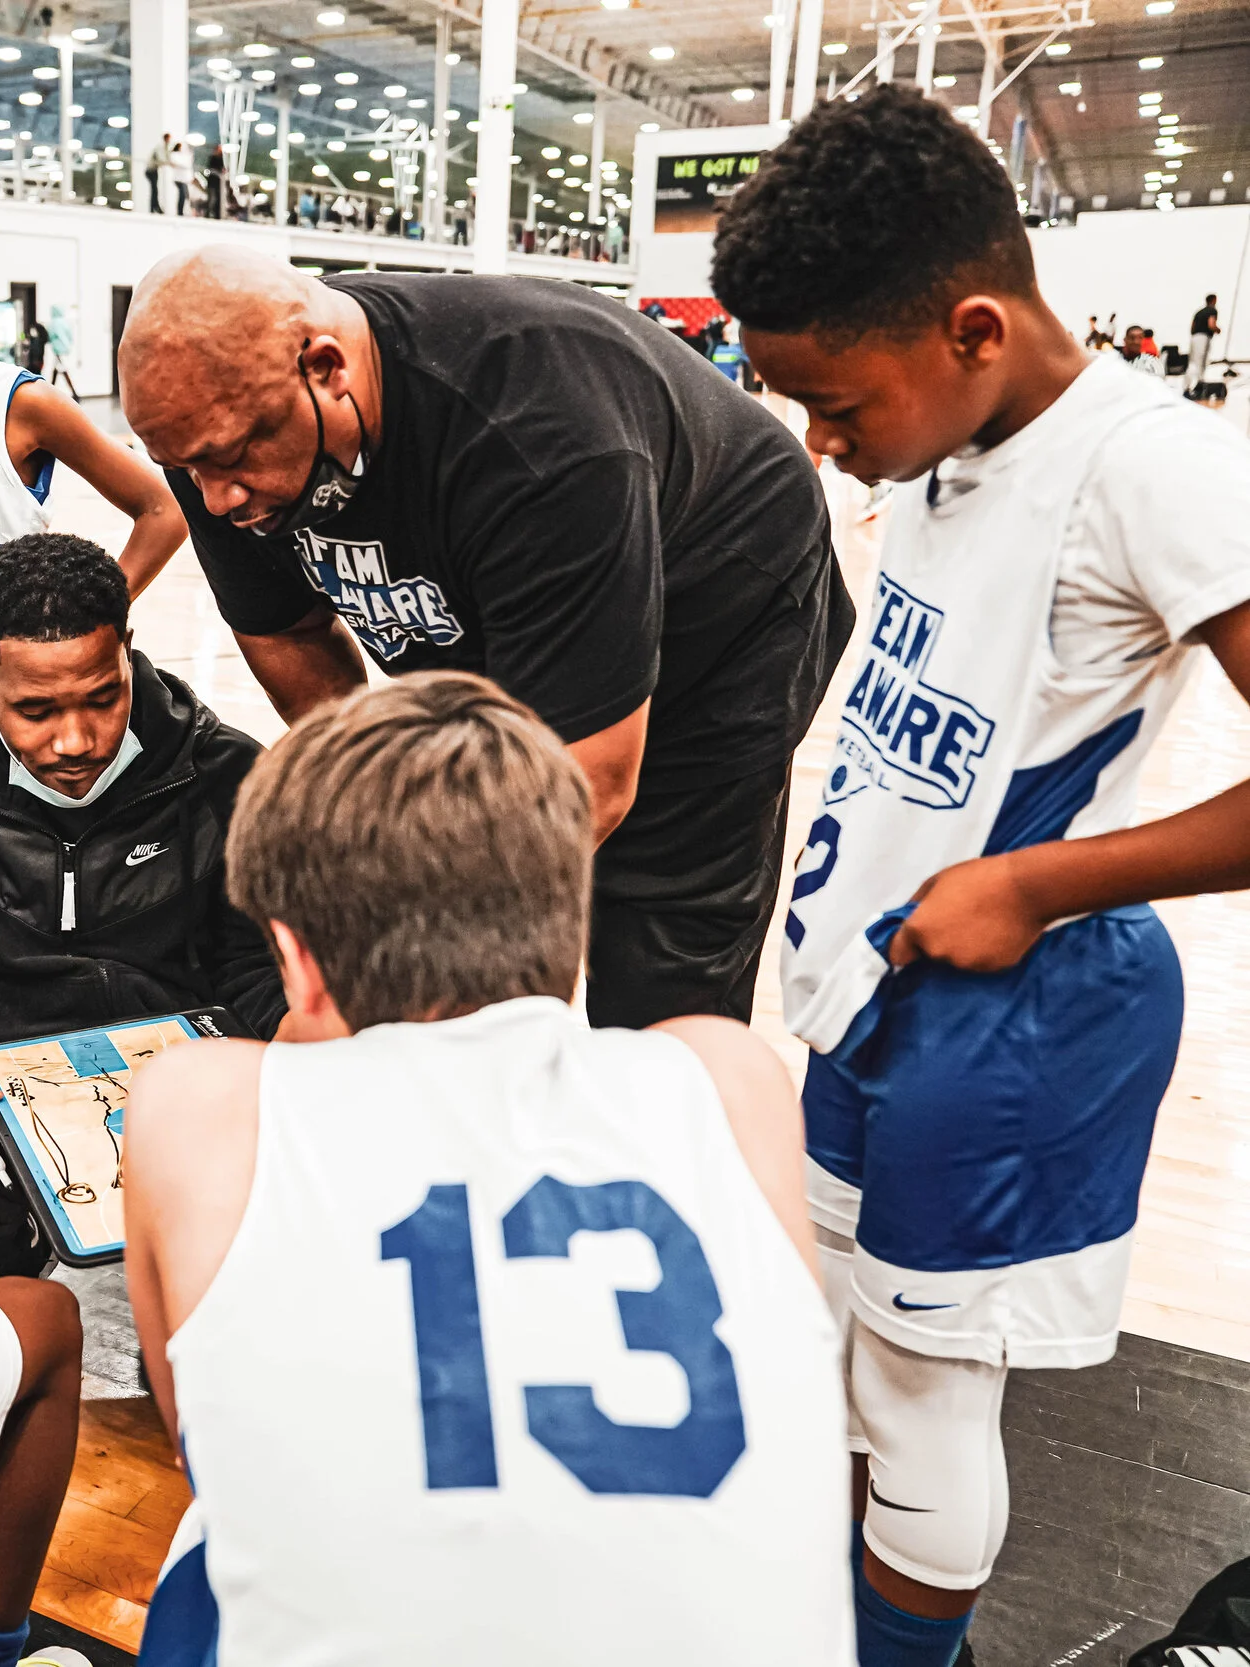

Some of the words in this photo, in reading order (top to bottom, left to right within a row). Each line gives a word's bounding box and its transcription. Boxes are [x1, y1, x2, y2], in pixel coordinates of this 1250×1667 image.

[674, 159, 698, 178] WE
[701, 157, 736, 178] GOT
[871, 584, 934, 675] EAM
[846, 659, 978, 788] AWARE
[132, 842, 161, 856] NIKE
[197, 1015, 223, 1036] Sport
[380, 1174, 747, 1499] 13
